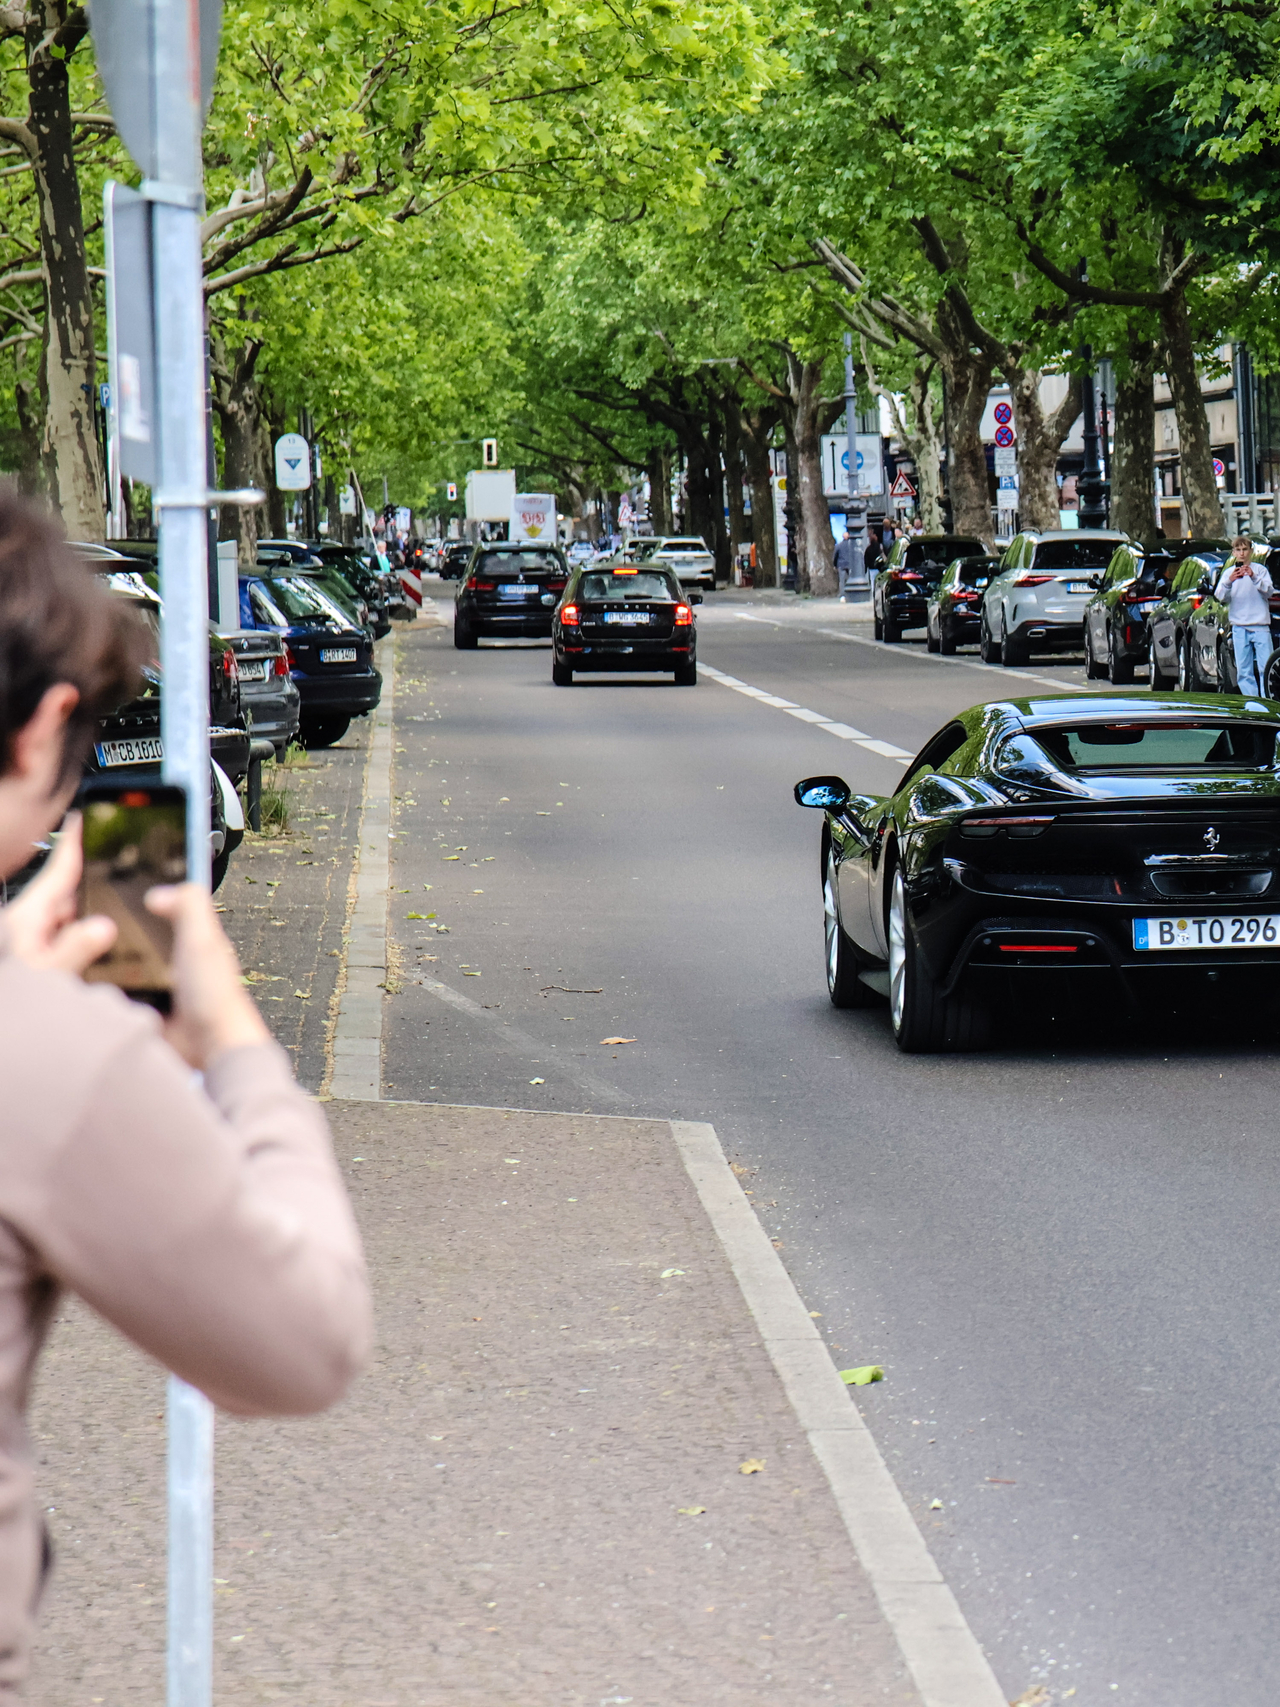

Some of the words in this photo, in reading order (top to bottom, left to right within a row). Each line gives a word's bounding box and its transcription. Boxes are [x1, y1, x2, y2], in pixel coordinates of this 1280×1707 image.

[103, 744, 113, 763] M
[118, 742, 135, 761] CB
[1159, 921, 1175, 945] B
[1192, 919, 1224, 944] TO
[1231, 918, 1277, 943] 296
